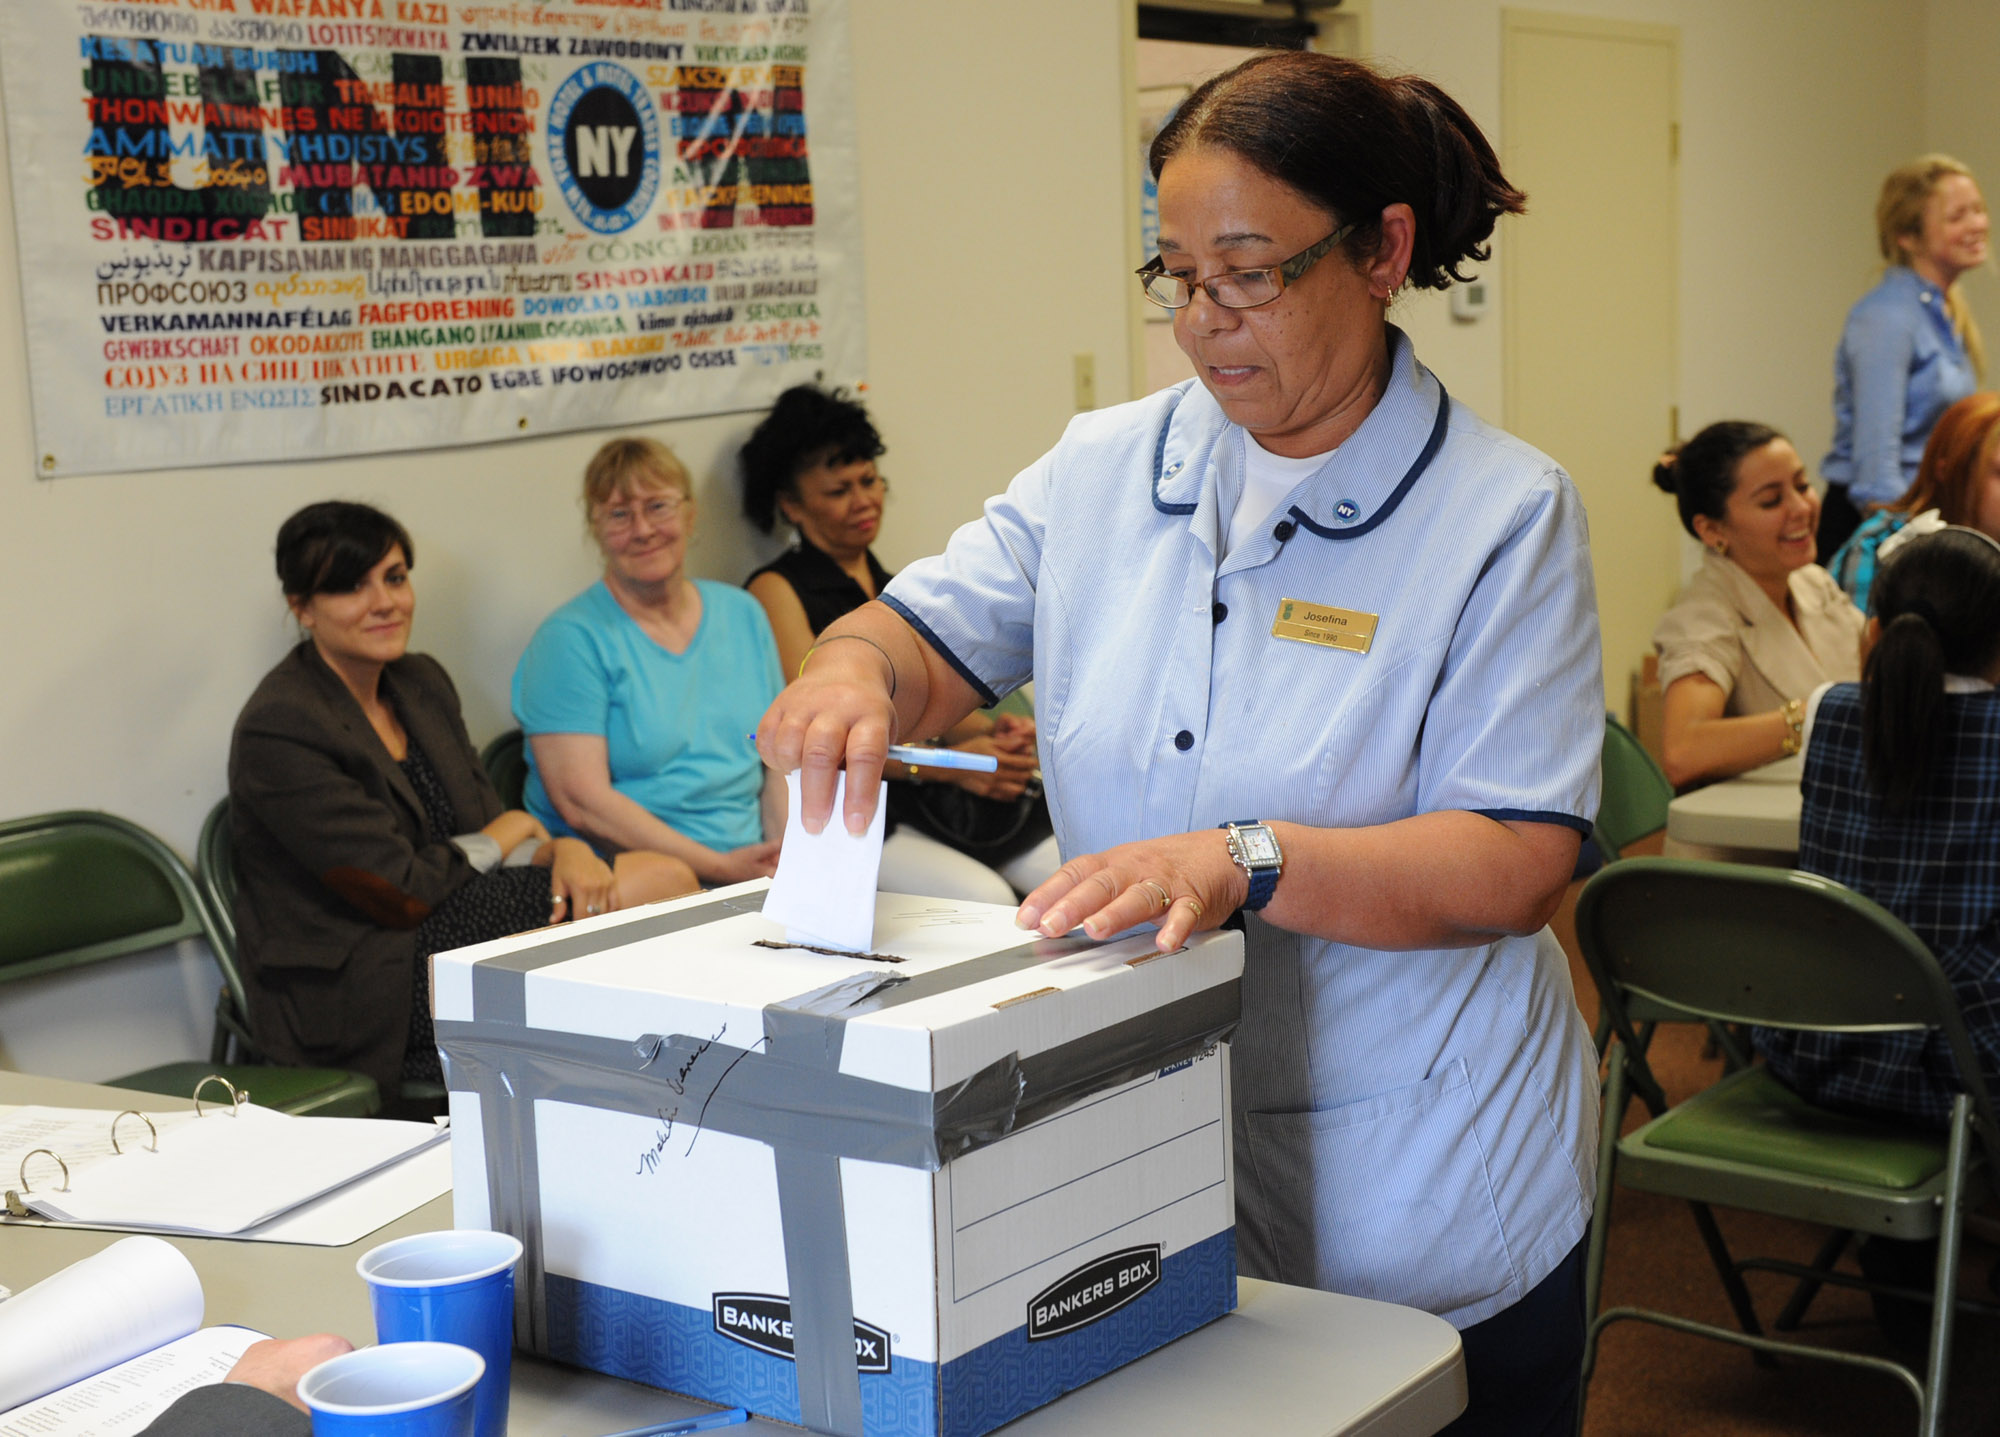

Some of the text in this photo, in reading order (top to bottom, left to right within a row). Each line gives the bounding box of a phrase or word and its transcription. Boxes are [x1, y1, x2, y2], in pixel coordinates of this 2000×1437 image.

[397, 3, 448, 24] KAZI
[80, 36, 223, 68] KESATUAN
[233, 48, 319, 73] BURUH
[574, 124, 638, 178] NY
[278, 164, 543, 188] MUBATANIDZWA
[90, 216, 289, 241] SINDICAT
[302, 216, 411, 240] SINDIKAT
[380, 243, 538, 270] MANGGAGAWA
[575, 263, 716, 291] SINDIKATU
[97, 280, 248, 306] ПРОФСОЮЗ
[100, 305, 352, 333] VERKAMANNAFÉLAG
[359, 297, 515, 325] FAGFORENING
[103, 335, 240, 361] GEWERKSCHAFT
[371, 324, 477, 350] EHANGANO
[104, 363, 189, 390] СОЈУЗ
[199, 361, 235, 385] НА
[105, 386, 317, 417] ΕΡΓΑΤΙΚΗ ΕΝΩΣΙΣ
[320, 375, 483, 406] SINDACATO
[1337, 504, 1355, 518] NY
[1303, 611, 1348, 626] Josefina
[1303, 629, 1321, 640] Since
[1035, 1259, 1152, 1327] BANKERS BOX
[723, 1305, 795, 1339] BANKE
